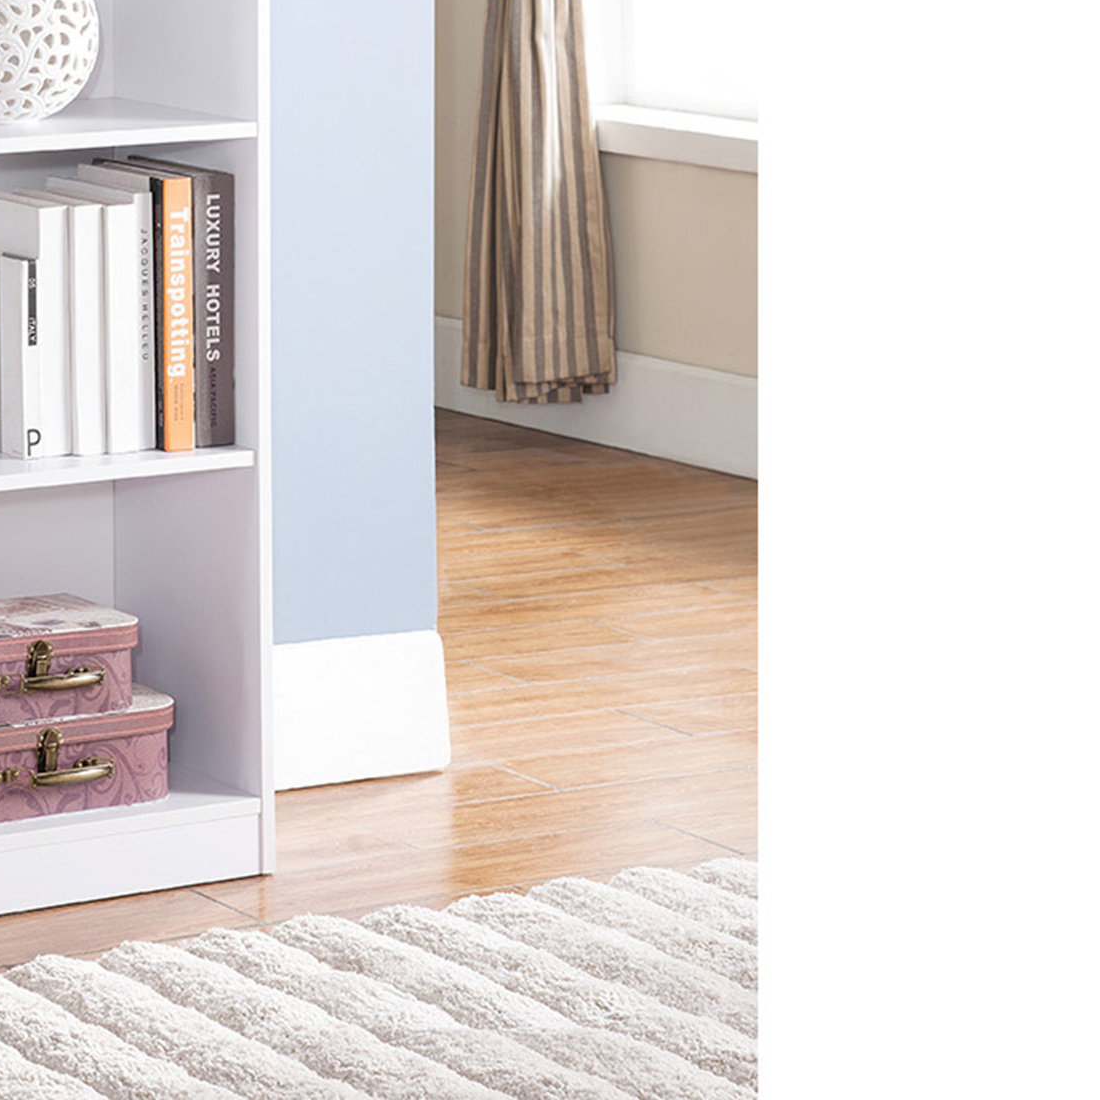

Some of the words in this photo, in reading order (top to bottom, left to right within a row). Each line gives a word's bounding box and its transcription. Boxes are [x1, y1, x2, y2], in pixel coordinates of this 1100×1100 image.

[140, 229, 149, 296] JACQUES
[206, 194, 220, 273] LUXURY
[206, 284, 220, 363] HOTELS
[27, 428, 42, 457] P
